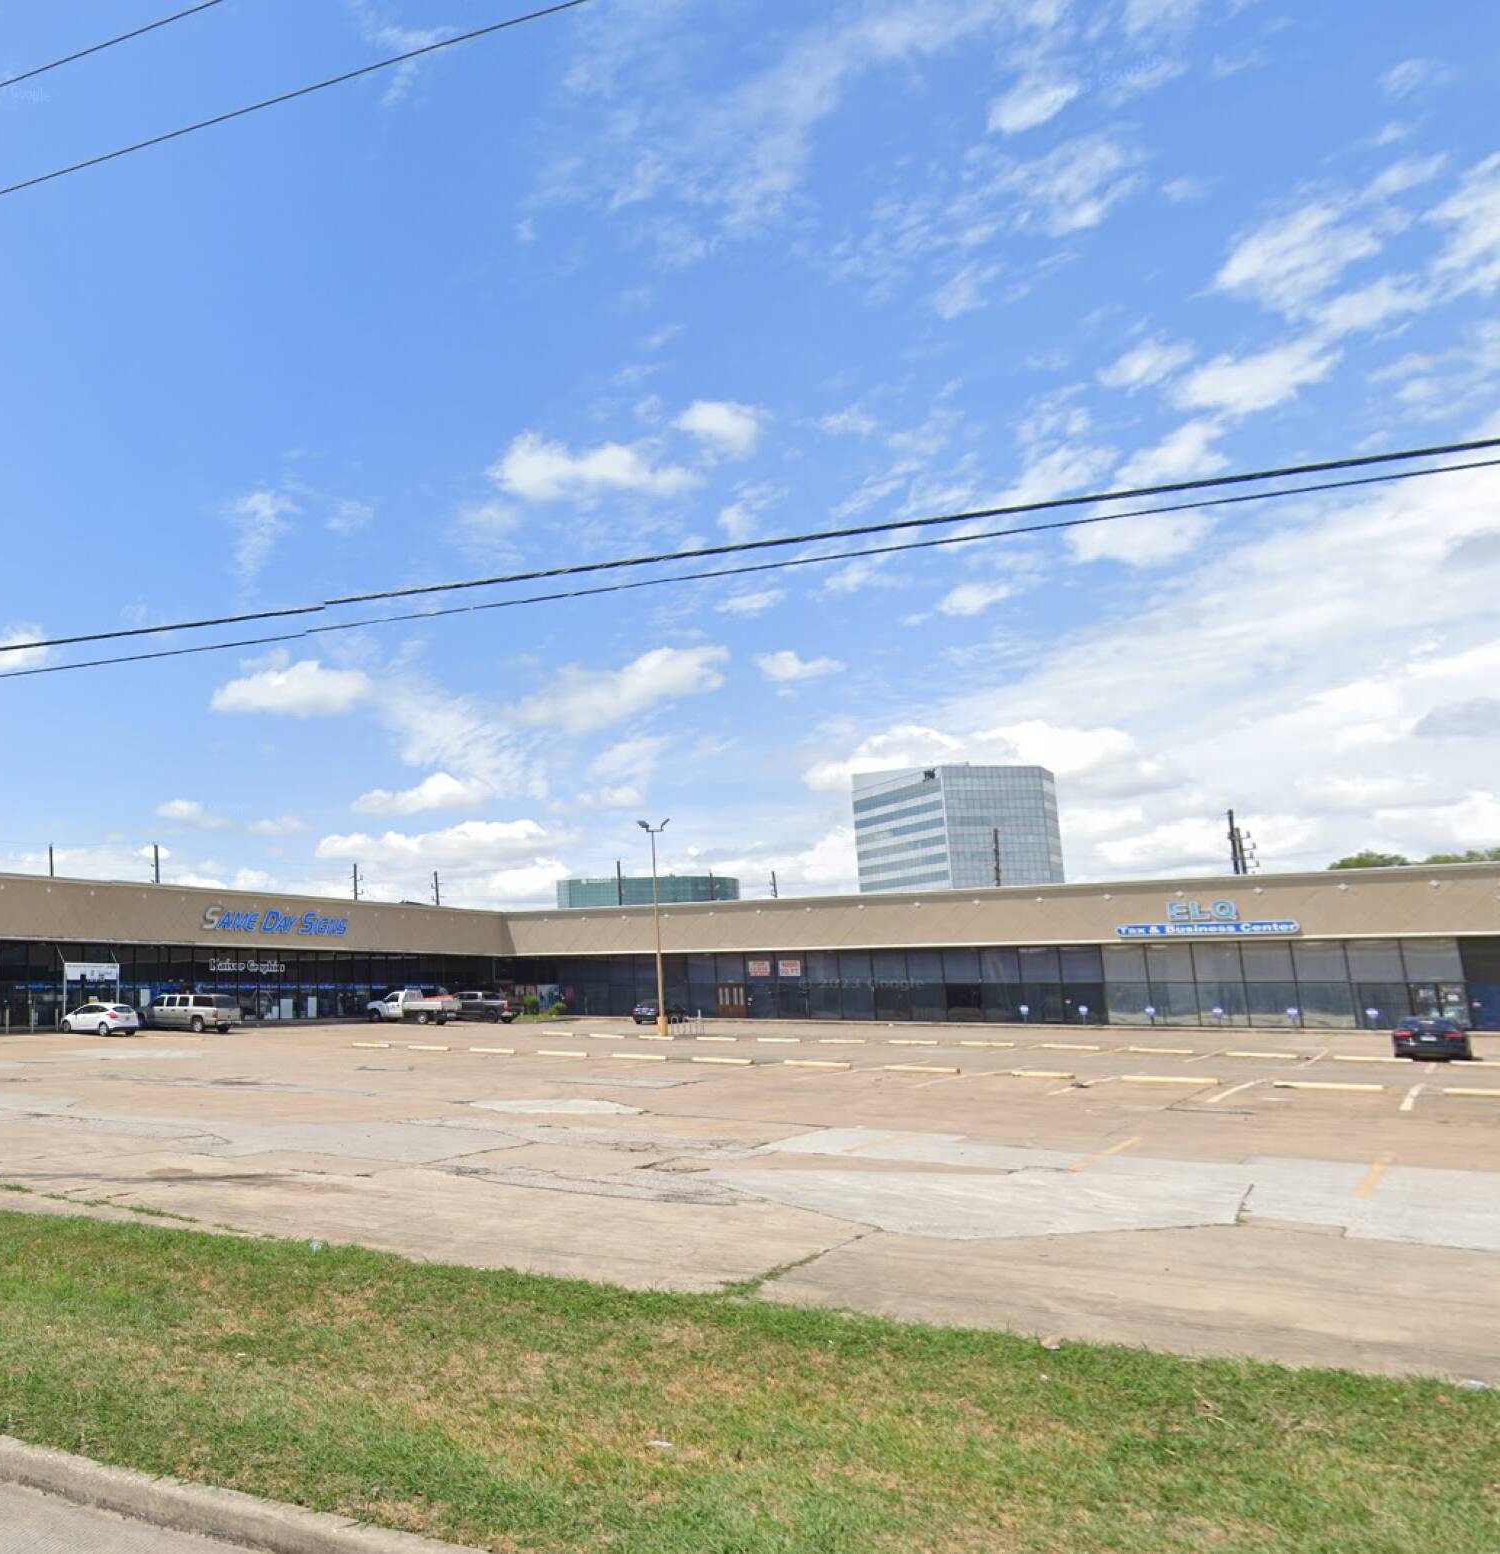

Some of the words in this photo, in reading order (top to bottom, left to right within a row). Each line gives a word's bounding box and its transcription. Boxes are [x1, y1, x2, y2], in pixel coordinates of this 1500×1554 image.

[1167, 899, 1239, 920] ELQ
[1118, 926, 1148, 934] Tax
[1149, 925, 1160, 934] &
[1165, 924, 1235, 934] Business
[1240, 922, 1295, 932] Center
